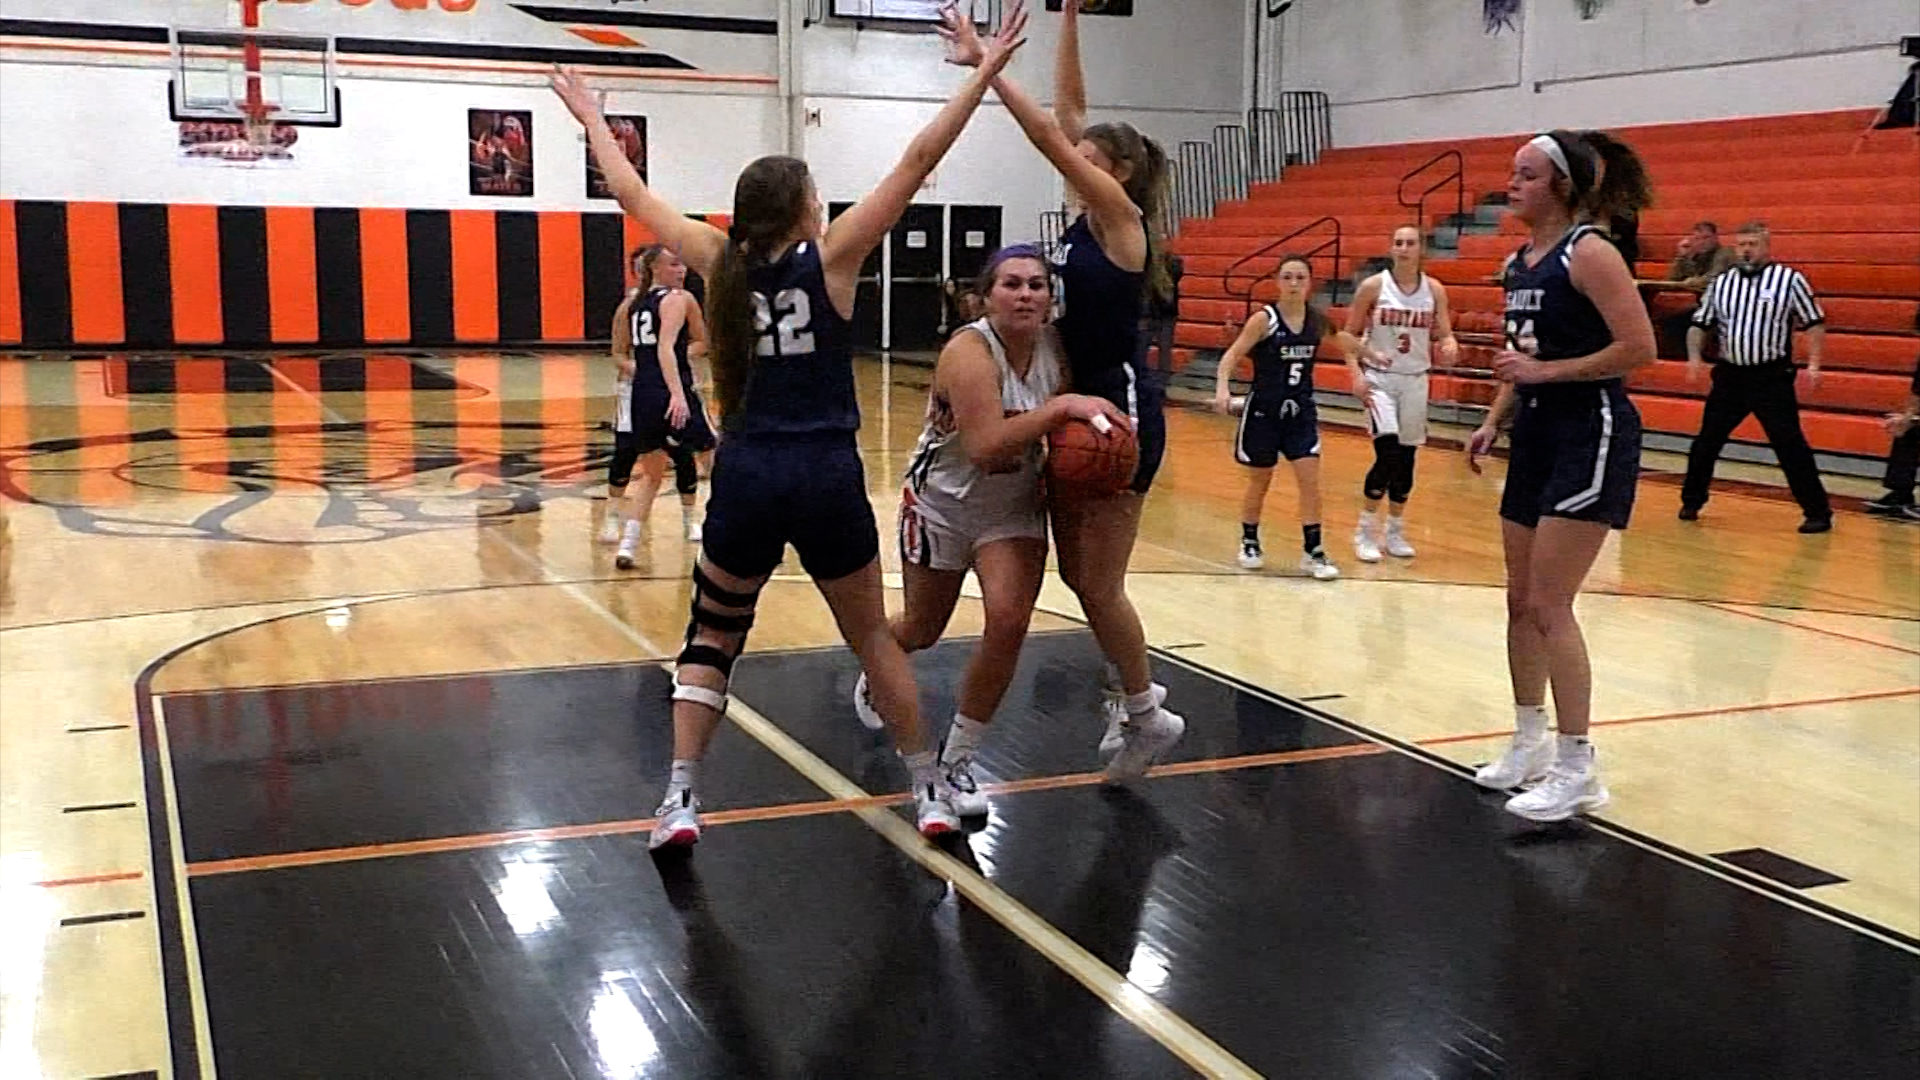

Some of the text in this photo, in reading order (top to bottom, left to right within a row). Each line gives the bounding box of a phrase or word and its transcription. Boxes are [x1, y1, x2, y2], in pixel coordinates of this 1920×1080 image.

[631, 310, 657, 346] 12
[750, 287, 815, 356] 22
[1397, 333, 1411, 354] 3
[1288, 363, 1303, 386] 5
